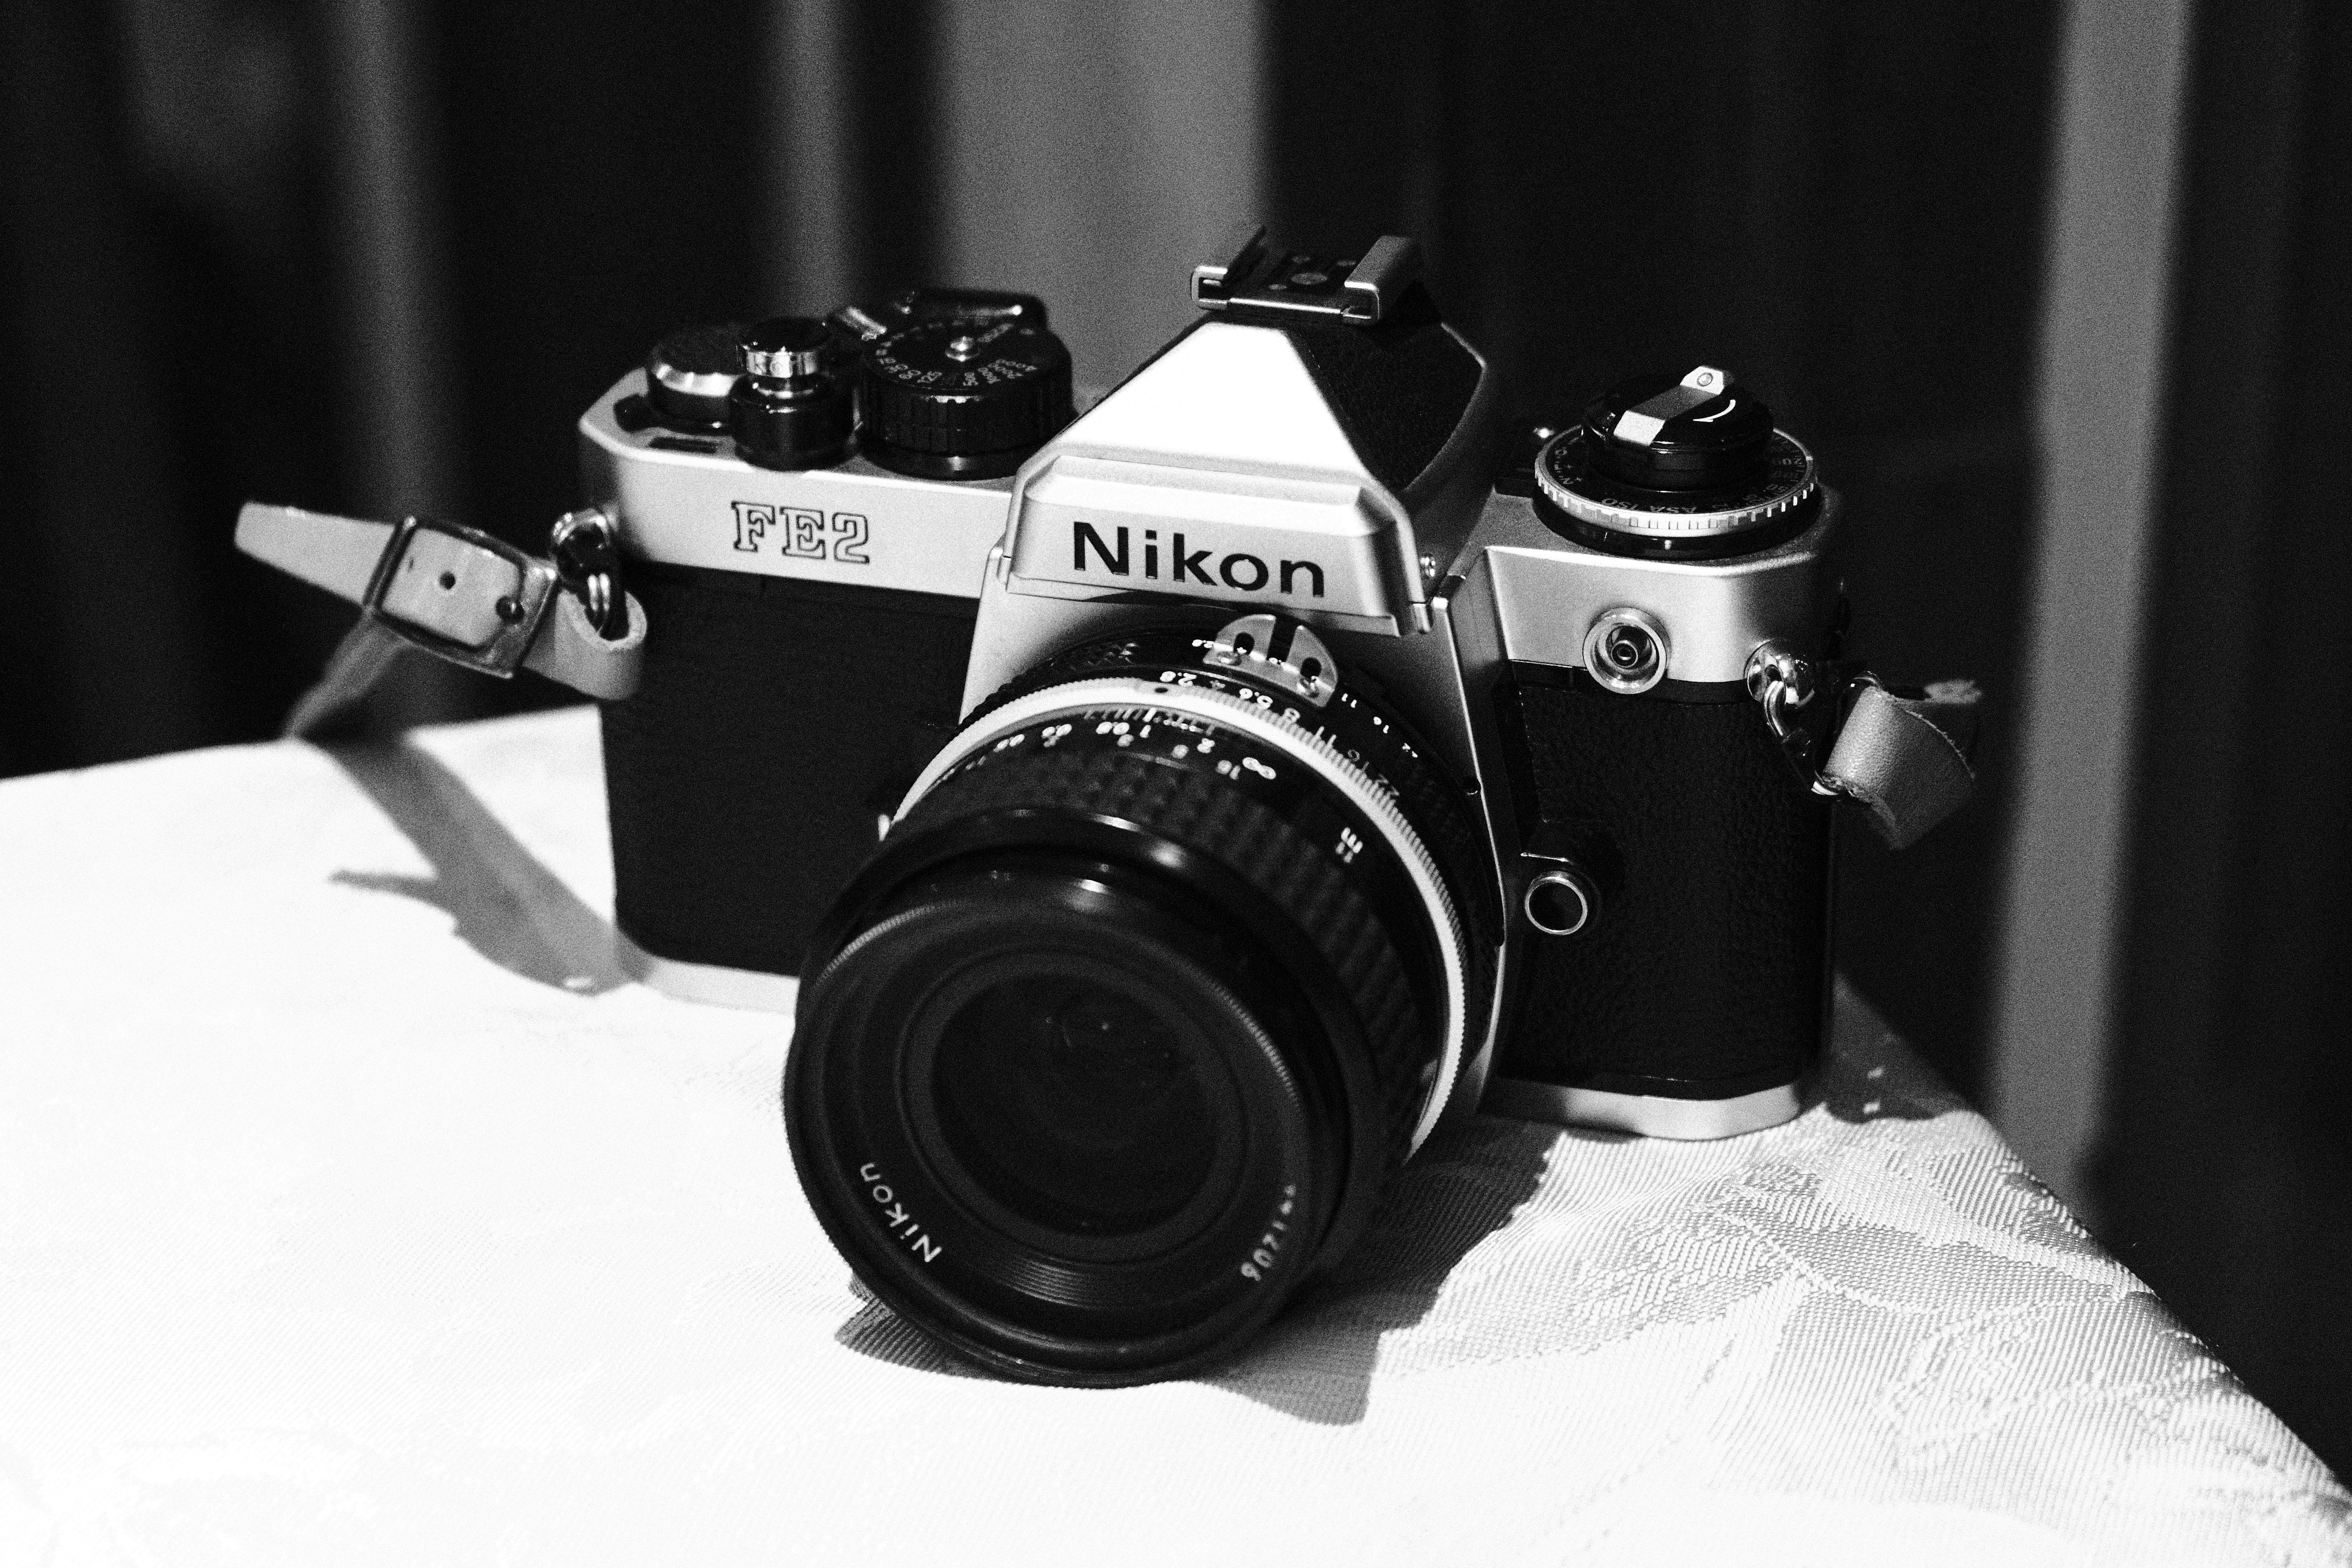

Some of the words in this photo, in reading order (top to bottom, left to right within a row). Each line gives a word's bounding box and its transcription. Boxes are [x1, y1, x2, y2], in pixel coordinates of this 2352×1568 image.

[730, 500, 870, 564] FE2
[1073, 521, 1325, 598] Nikon
[1160, 671, 1197, 686] 2.8
[860, 1163, 942, 1263] Nikon
